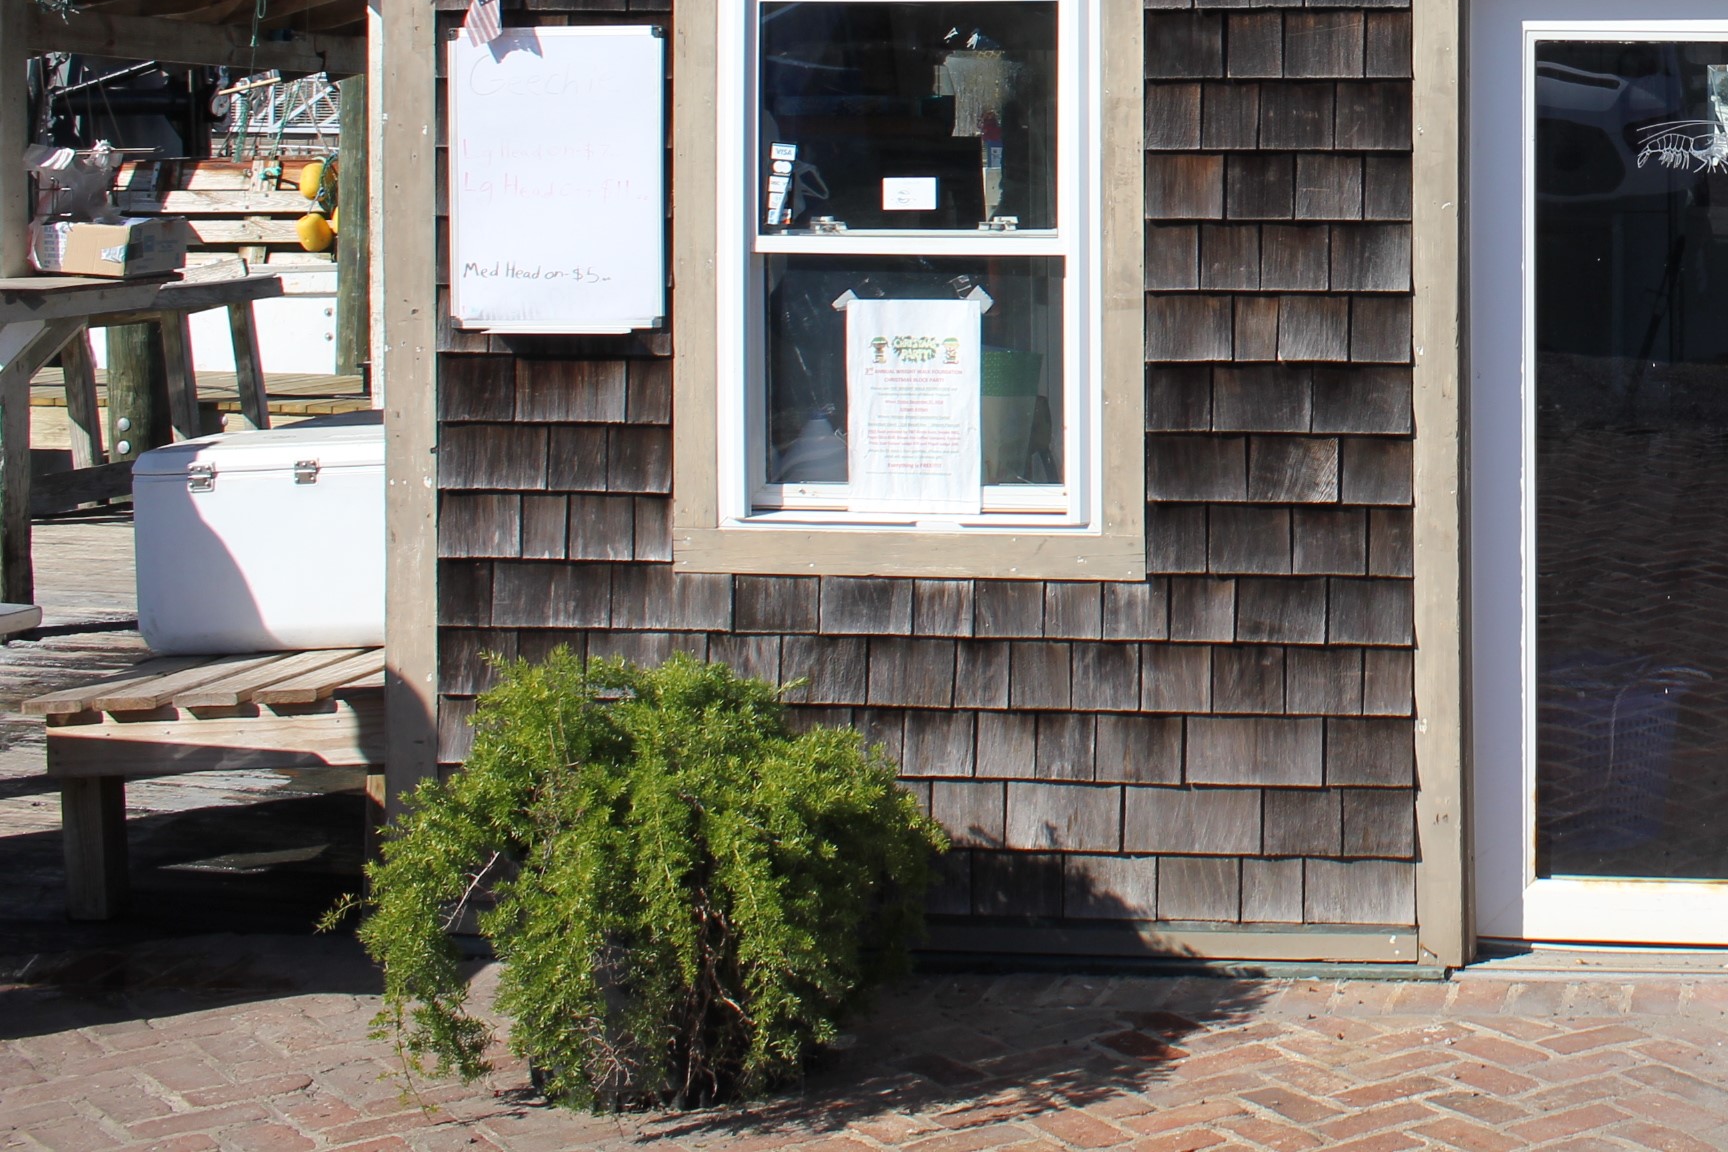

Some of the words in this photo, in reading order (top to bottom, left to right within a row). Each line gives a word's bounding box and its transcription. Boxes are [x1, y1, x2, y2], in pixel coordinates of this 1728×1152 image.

[470, 53, 623, 96] Geechie
[776, 148, 793, 156] VISA
[464, 171, 493, 204] Lg
[504, 172, 554, 199] Head
[463, 261, 500, 279] Med
[506, 261, 541, 279] Head
